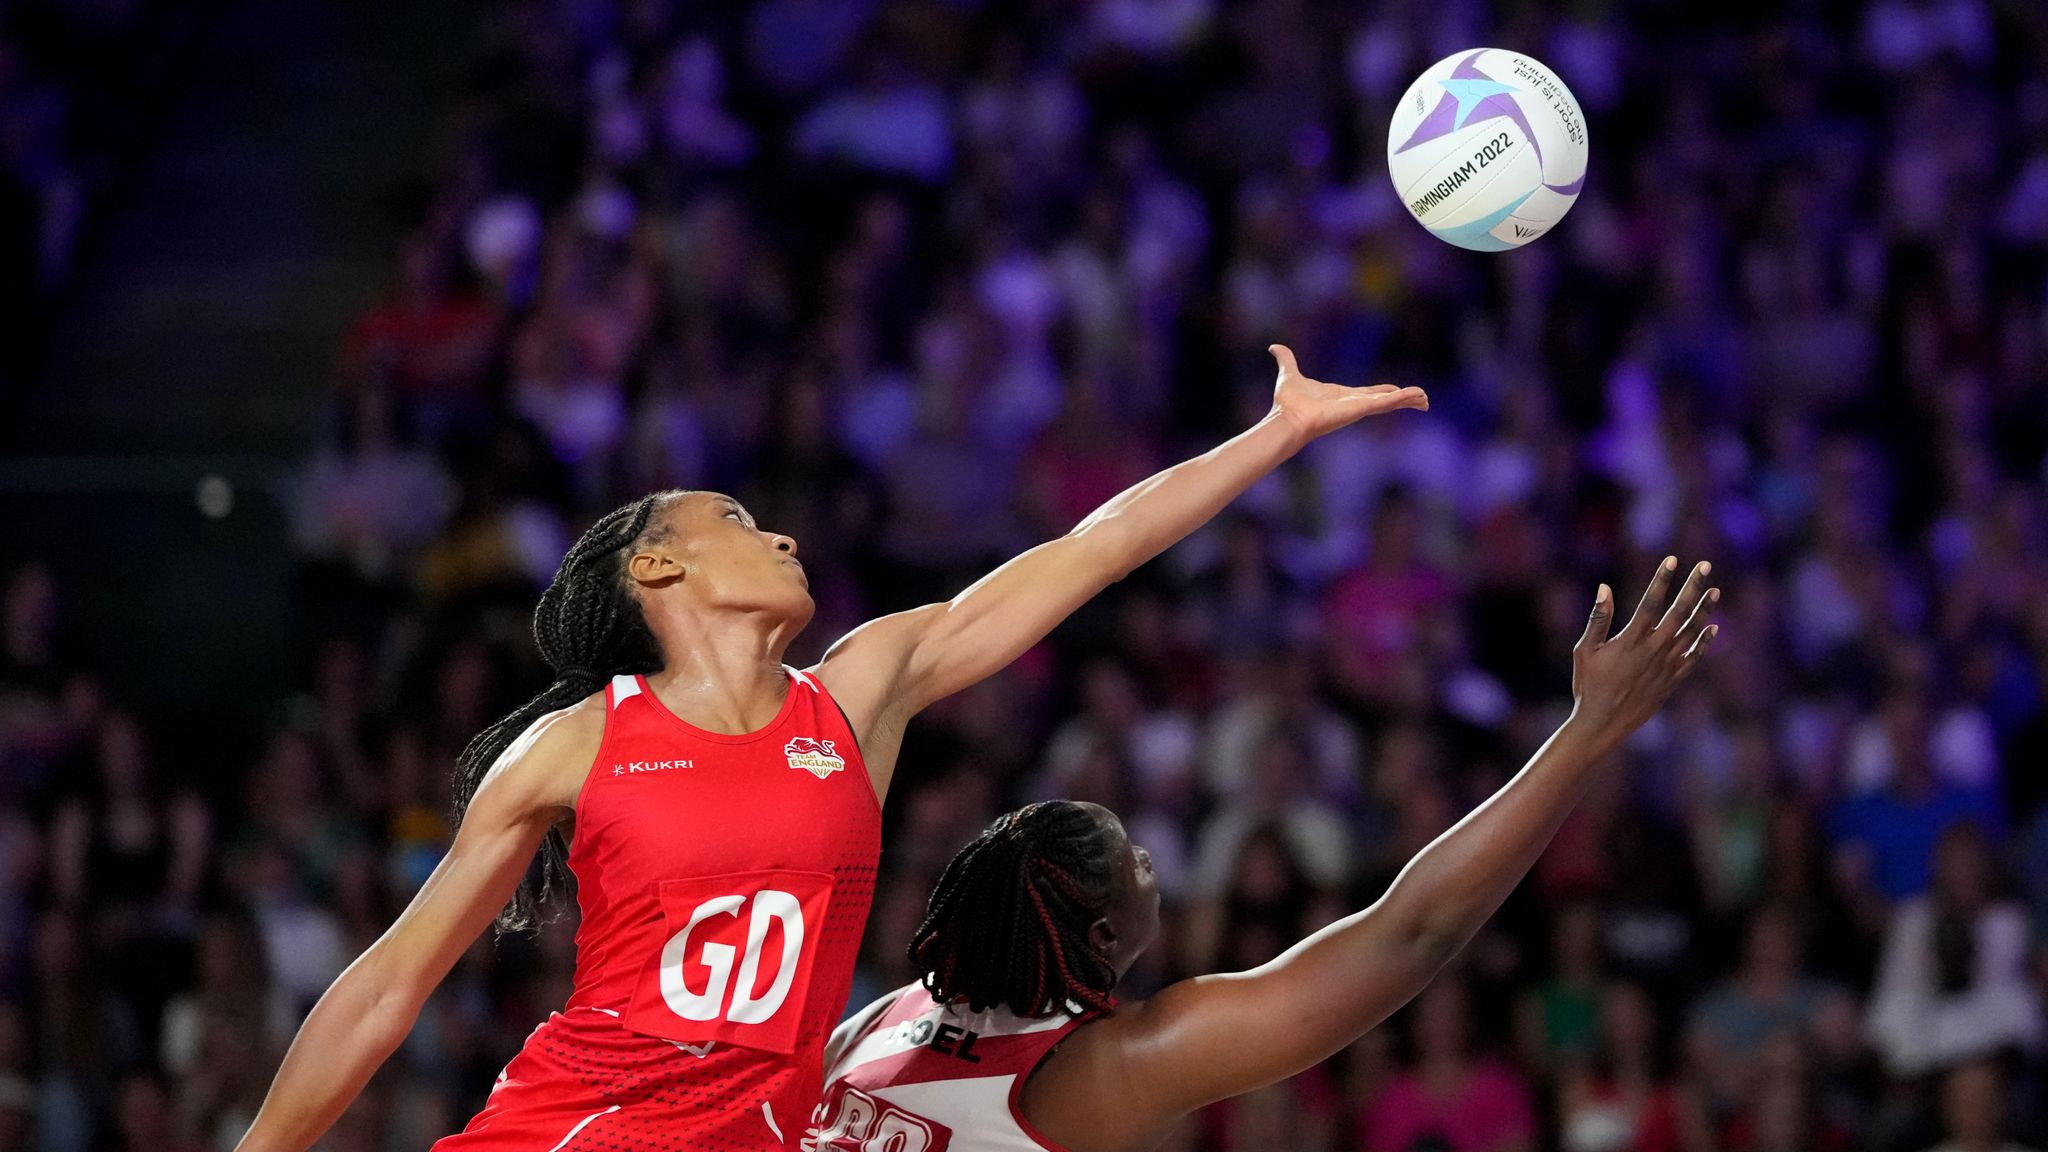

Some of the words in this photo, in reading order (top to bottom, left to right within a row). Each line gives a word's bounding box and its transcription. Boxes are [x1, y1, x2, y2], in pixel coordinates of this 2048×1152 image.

[1513, 59, 1574, 116] beginning
[1514, 67, 1543, 87] just
[1542, 87, 1553, 100] is
[1554, 102, 1577, 142] sport
[1574, 119, 1584, 145] the
[1411, 161, 1477, 217] BIRMINGHAM
[1474, 132, 1514, 168] 2022
[629, 760, 693, 773] KUKRI
[791, 760, 842, 769] ENGLAND
[660, 890, 804, 1024] GD
